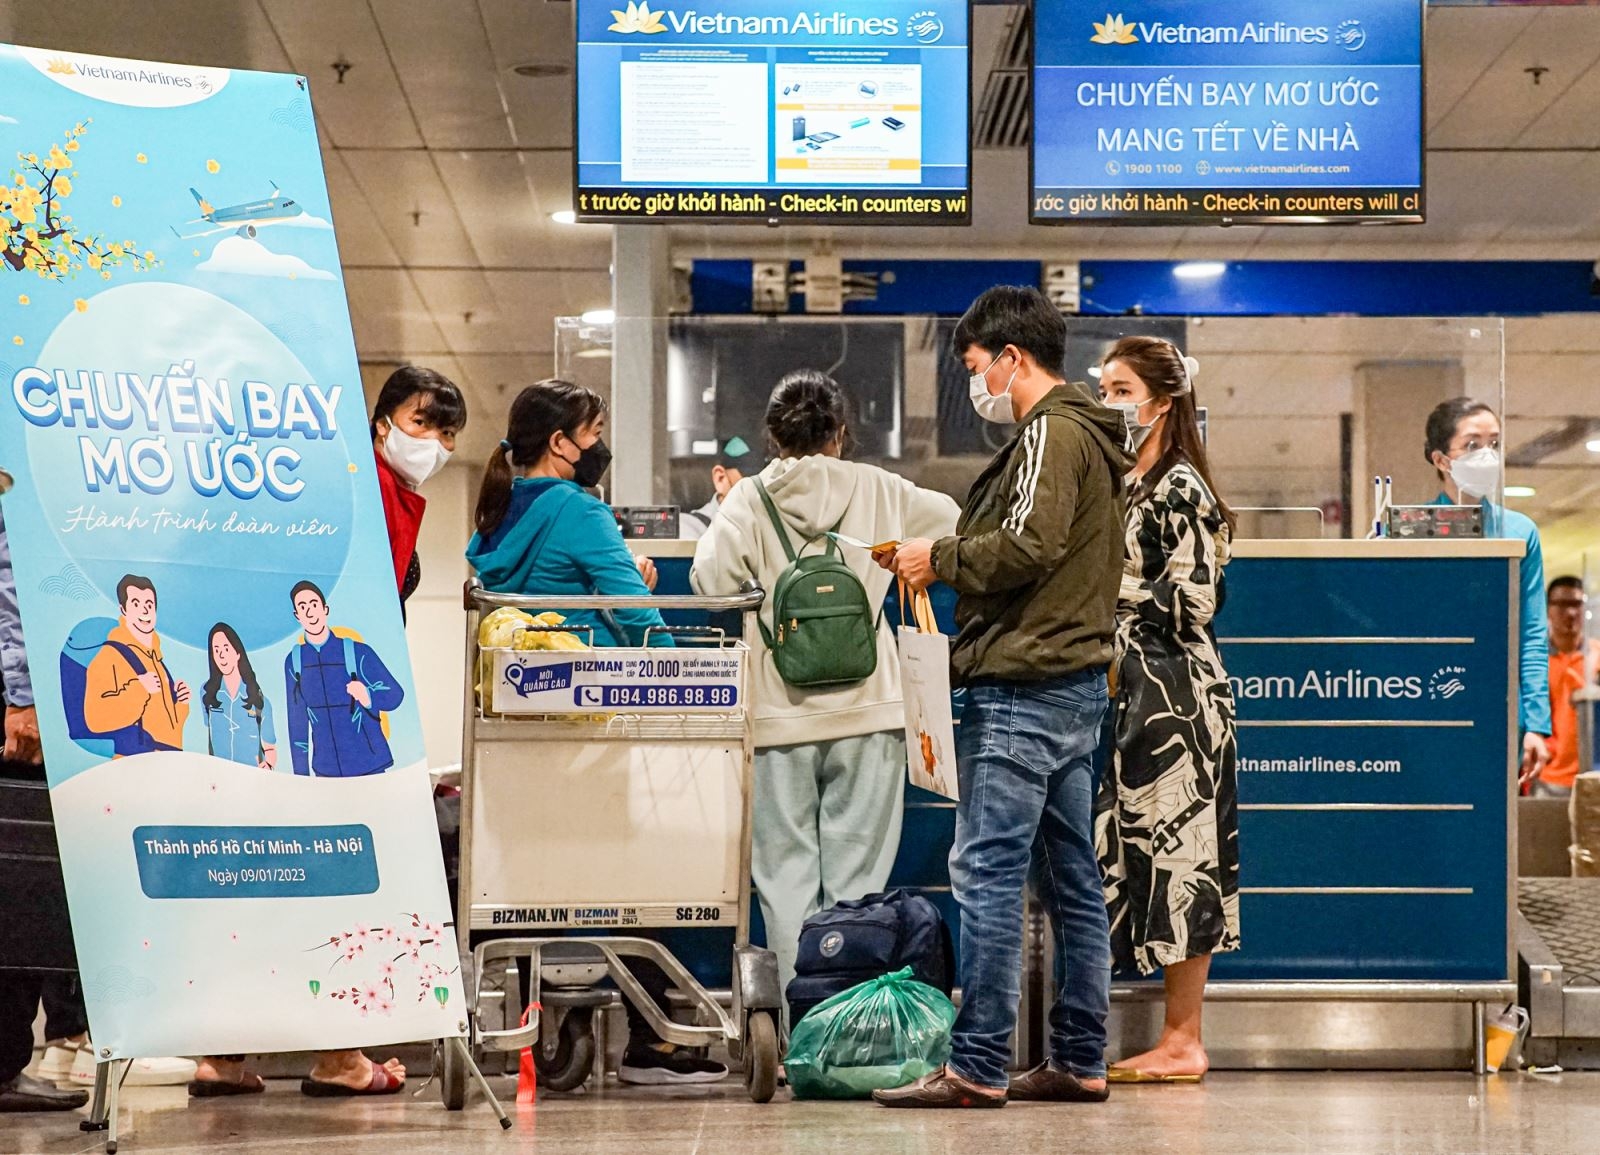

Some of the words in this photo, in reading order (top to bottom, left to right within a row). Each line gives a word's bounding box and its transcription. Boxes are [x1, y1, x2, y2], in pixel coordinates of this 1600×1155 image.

[668, 10, 791, 35] Vietnam
[791, 12, 899, 37] Airlines
[1138, 22, 1237, 44] Vietnam
[1239, 23, 1329, 44] Airlines
[75, 62, 138, 84] Vietnam
[138, 70, 192, 89] Airlines
[1076, 75, 1192, 107] CHUYẾN
[1201, 82, 1257, 107] BAY
[1264, 81, 1313, 107] MƠ
[1318, 76, 1379, 107] ƯỚC
[1097, 127, 1184, 153] MANG
[1191, 120, 1246, 152] TẾT
[1251, 120, 1289, 152] VỀ
[1297, 122, 1360, 152] NHÀ
[1125, 164, 1153, 175] 1900
[1156, 164, 1183, 175] 1100
[1214, 163, 1351, 175] www.vietnamairlines.com
[579, 196, 588, 211] t
[591, 193, 640, 212] trước
[645, 194, 675, 216] giờ
[678, 191, 716, 212] khởi
[721, 193, 766, 212] hành
[780, 194, 858, 213] Check-in
[862, 196, 942, 213] counters
[945, 195, 966, 213] wi
[1069, 194, 1098, 215] giờ
[1102, 191, 1139, 211] khởi
[1143, 192, 1188, 212] hành
[1203, 194, 1281, 212] Check-in
[1285, 196, 1363, 212] counters
[1368, 194, 1399, 211] will
[1403, 194, 1418, 211] cl
[12, 359, 236, 435] CHUYẾN
[242, 381, 343, 440] BAY
[78, 434, 175, 495] MƠ
[184, 431, 306, 502] ƯỚC
[61, 504, 149, 533] Hành
[151, 505, 218, 534] trình
[285, 514, 339, 536] viên
[574, 661, 623, 672] BIZMAN
[638, 660, 680, 678] 20.000
[1298, 669, 1422, 699] Airlines
[610, 688, 731, 705] 094.986.98.98
[144, 839, 190, 856] Thành
[192, 839, 218, 859] phố
[221, 839, 241, 855] Hồ
[243, 839, 265, 855] Chí
[268, 840, 303, 855] Minh
[314, 838, 333, 854] Hà
[336, 837, 364, 856] Nội
[208, 868, 239, 886] Ngày
[241, 868, 306, 883] 09/01/2023
[492, 908, 569, 925] BIZMAN.VN
[574, 908, 618, 918] BIZMAN
[676, 908, 693, 921] SG
[695, 907, 720, 921] 280
